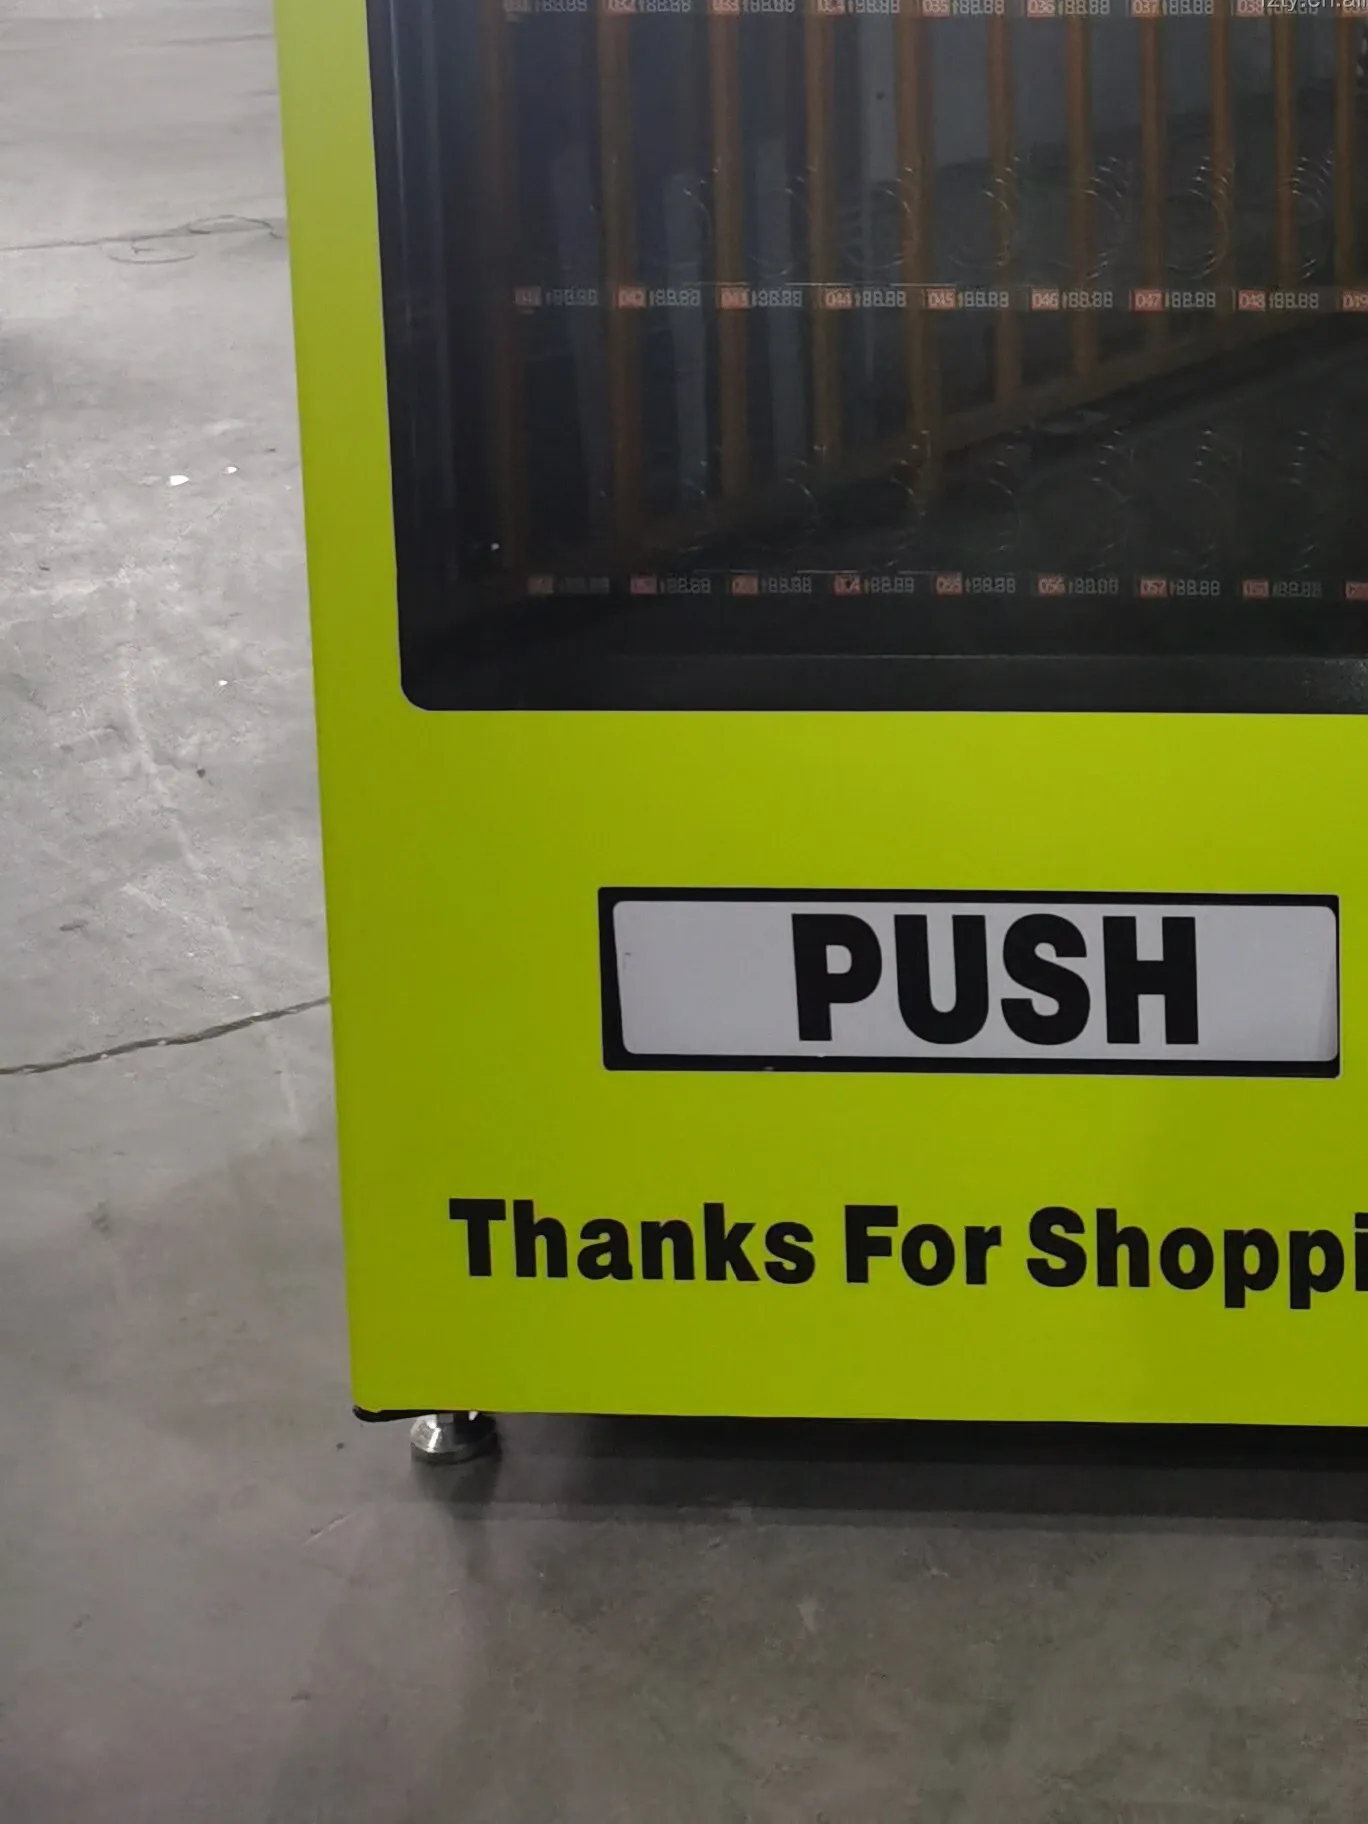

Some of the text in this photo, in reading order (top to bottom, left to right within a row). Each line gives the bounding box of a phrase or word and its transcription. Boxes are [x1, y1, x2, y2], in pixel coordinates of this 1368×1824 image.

[928, 290, 955, 307] 045
[1031, 291, 1059, 308] 046
[1135, 291, 1163, 308] 047
[791, 912, 1199, 1045] PUSH
[449, 1197, 815, 1285] Thanks
[844, 1205, 1001, 1285] For
